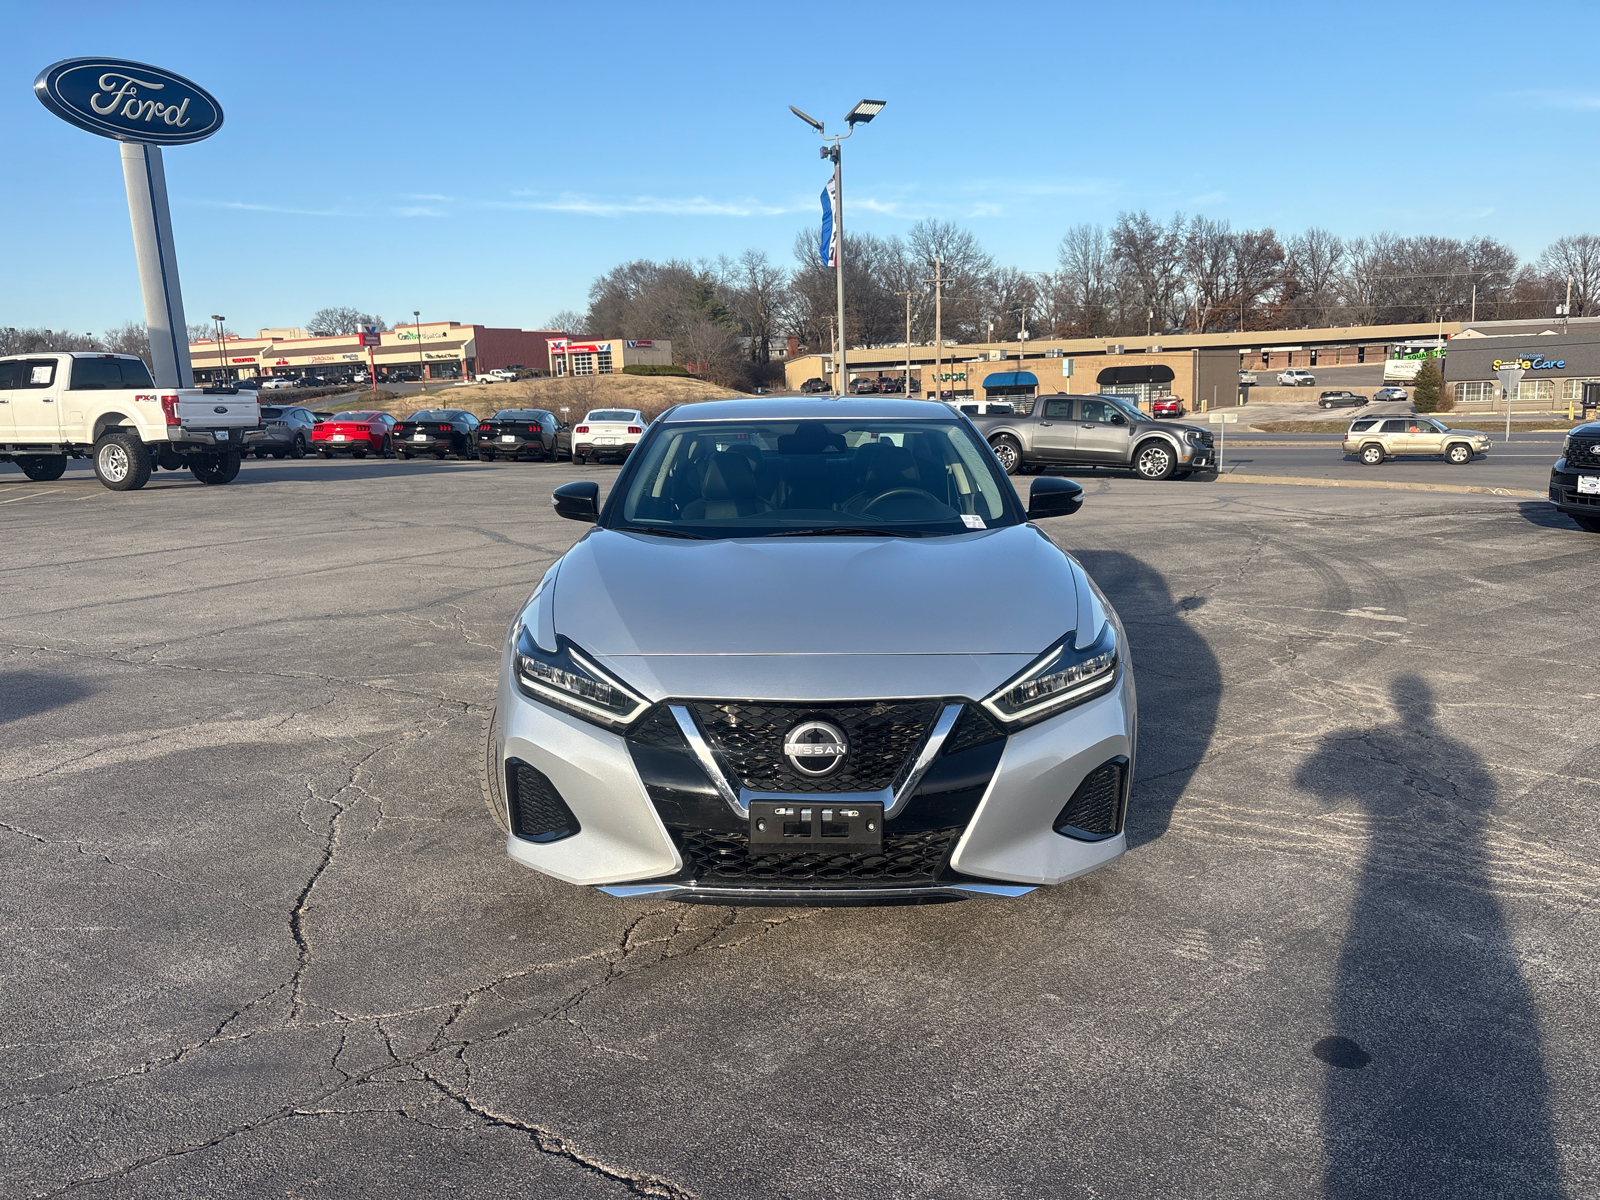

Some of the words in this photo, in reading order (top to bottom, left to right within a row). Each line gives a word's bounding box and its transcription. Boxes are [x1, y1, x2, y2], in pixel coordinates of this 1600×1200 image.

[90, 72, 191, 128] Ford
[1532, 358, 1566, 369] Care
[785, 745, 846, 755] NISSAN
